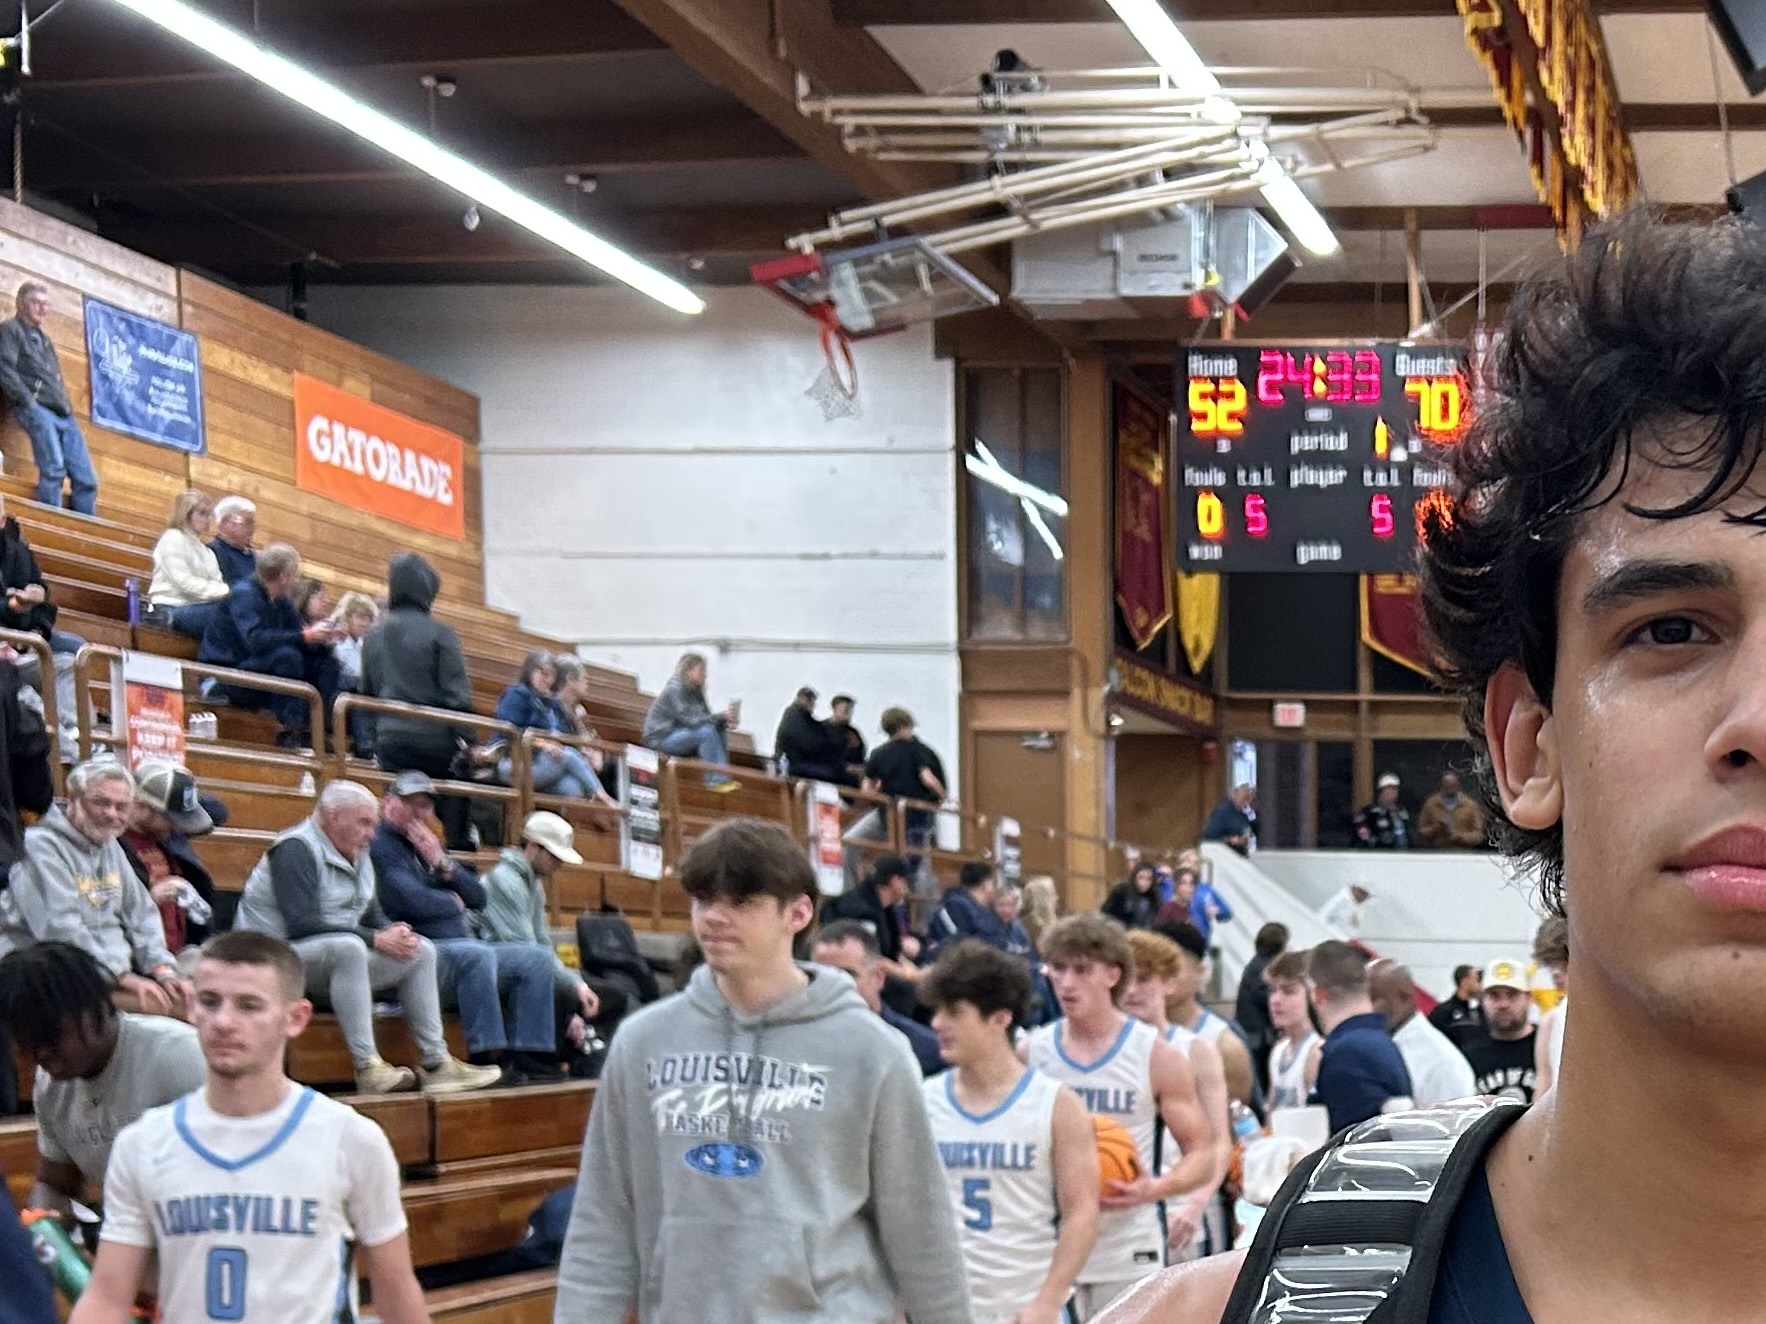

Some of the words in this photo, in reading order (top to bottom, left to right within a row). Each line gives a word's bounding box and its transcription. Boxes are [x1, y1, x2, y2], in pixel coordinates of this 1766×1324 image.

[1257, 350, 1381, 403] 24:33
[1188, 376, 1247, 434] 52
[1404, 377, 1462, 432] 70
[307, 415, 454, 506] GATORADE
[1196, 491, 1225, 538] 0
[1243, 494, 1269, 536] 5
[1370, 493, 1395, 537] 5
[154, 1192, 318, 1236] LOUISVILLE
[962, 1177, 993, 1232] 5
[205, 1245, 248, 1322] 0
